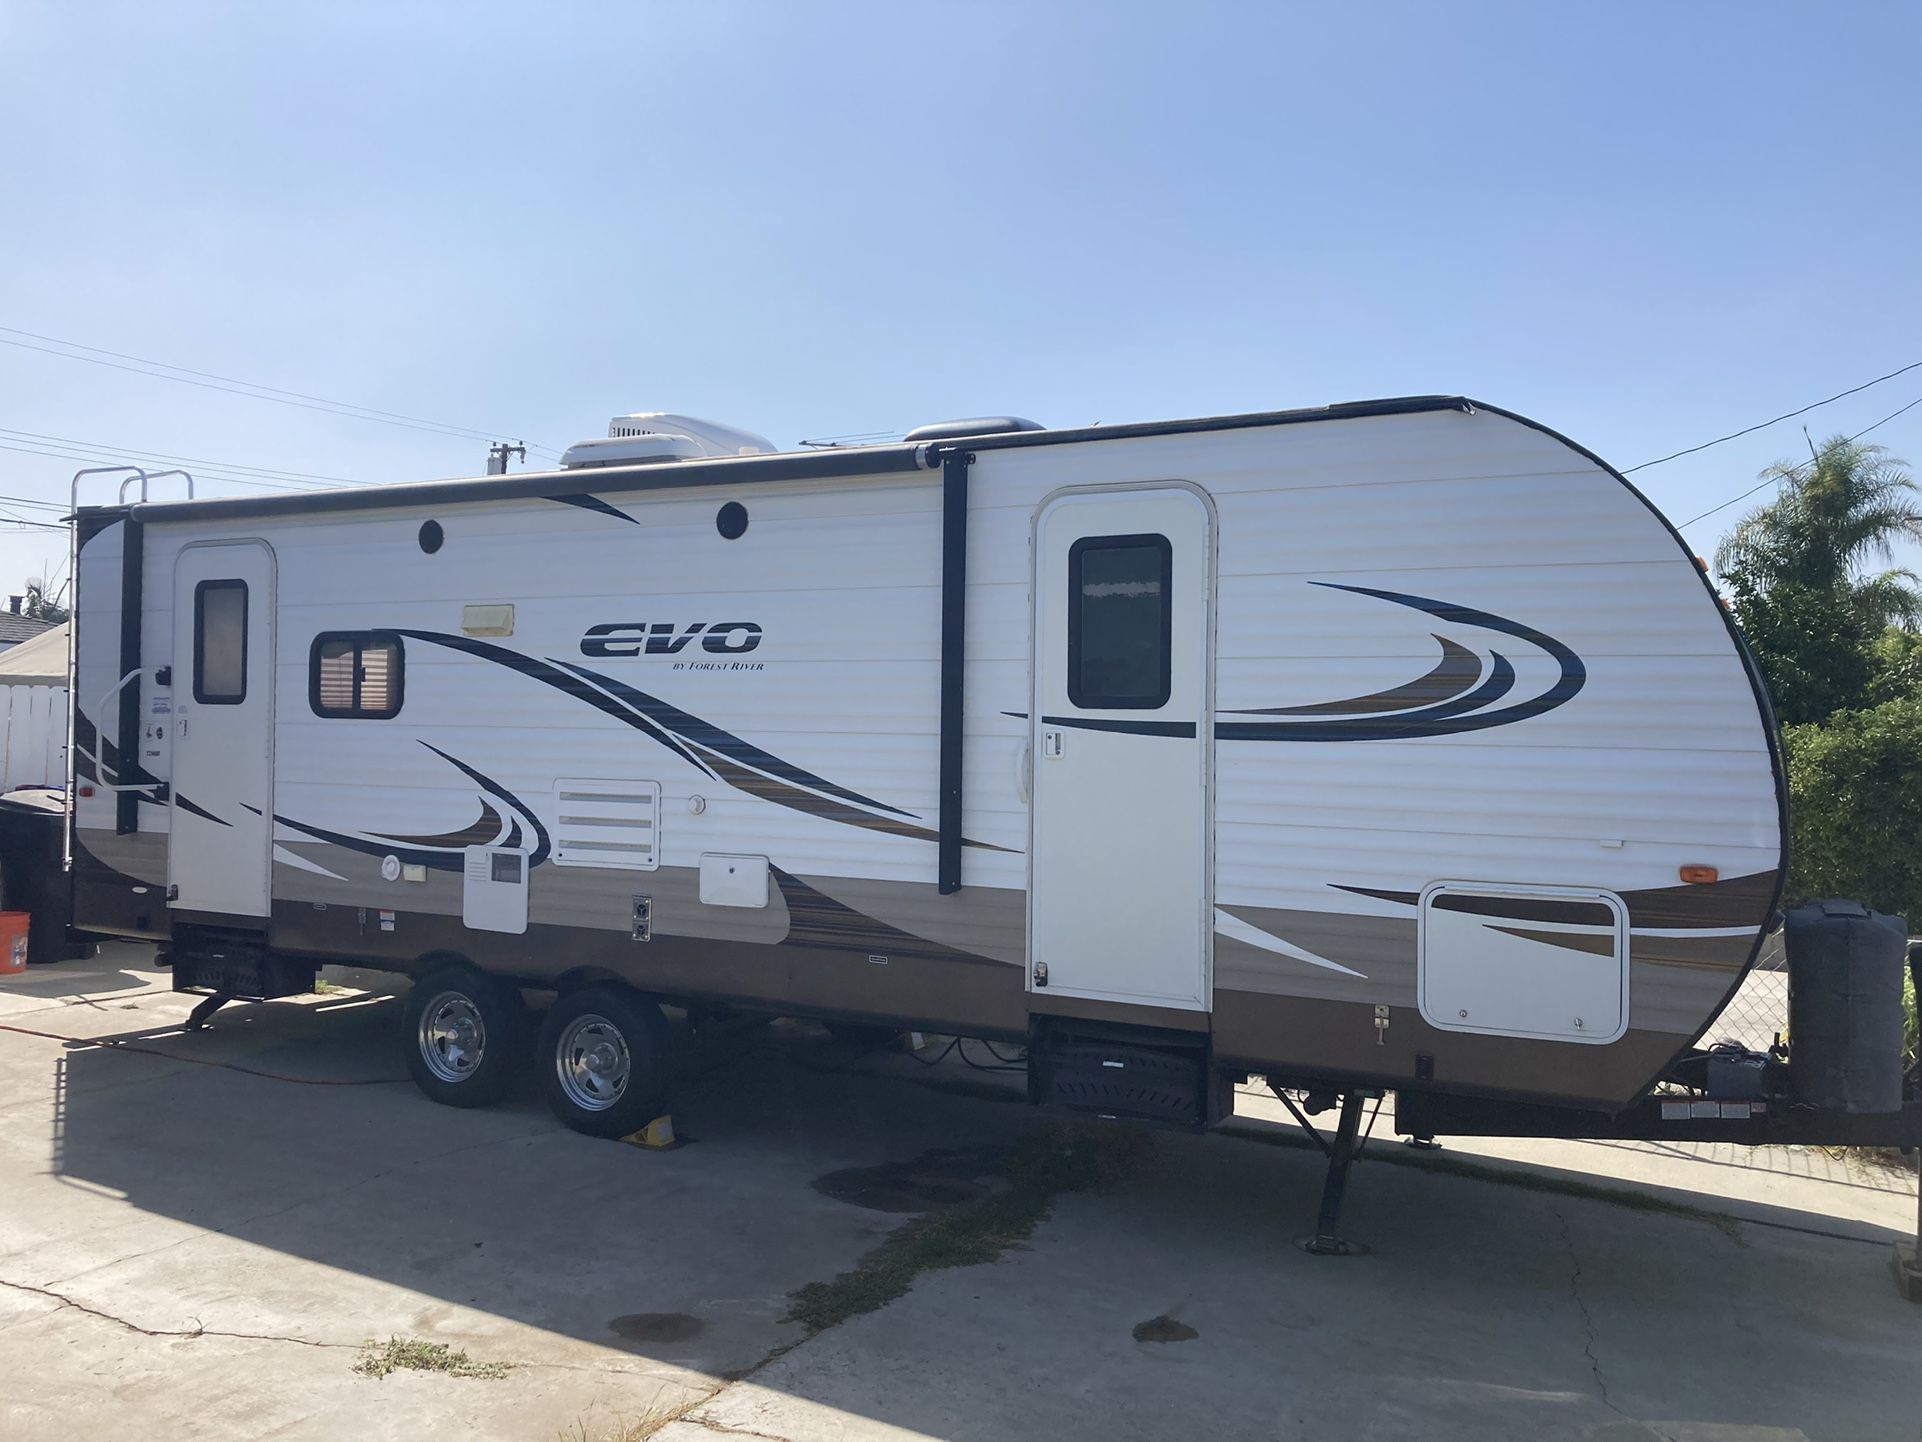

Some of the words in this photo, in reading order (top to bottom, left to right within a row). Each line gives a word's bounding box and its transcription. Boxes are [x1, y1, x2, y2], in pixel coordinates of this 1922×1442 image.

[580, 622, 763, 657] EVO
[688, 662, 729, 671] FOREST
[730, 662, 765, 671] RIVER
